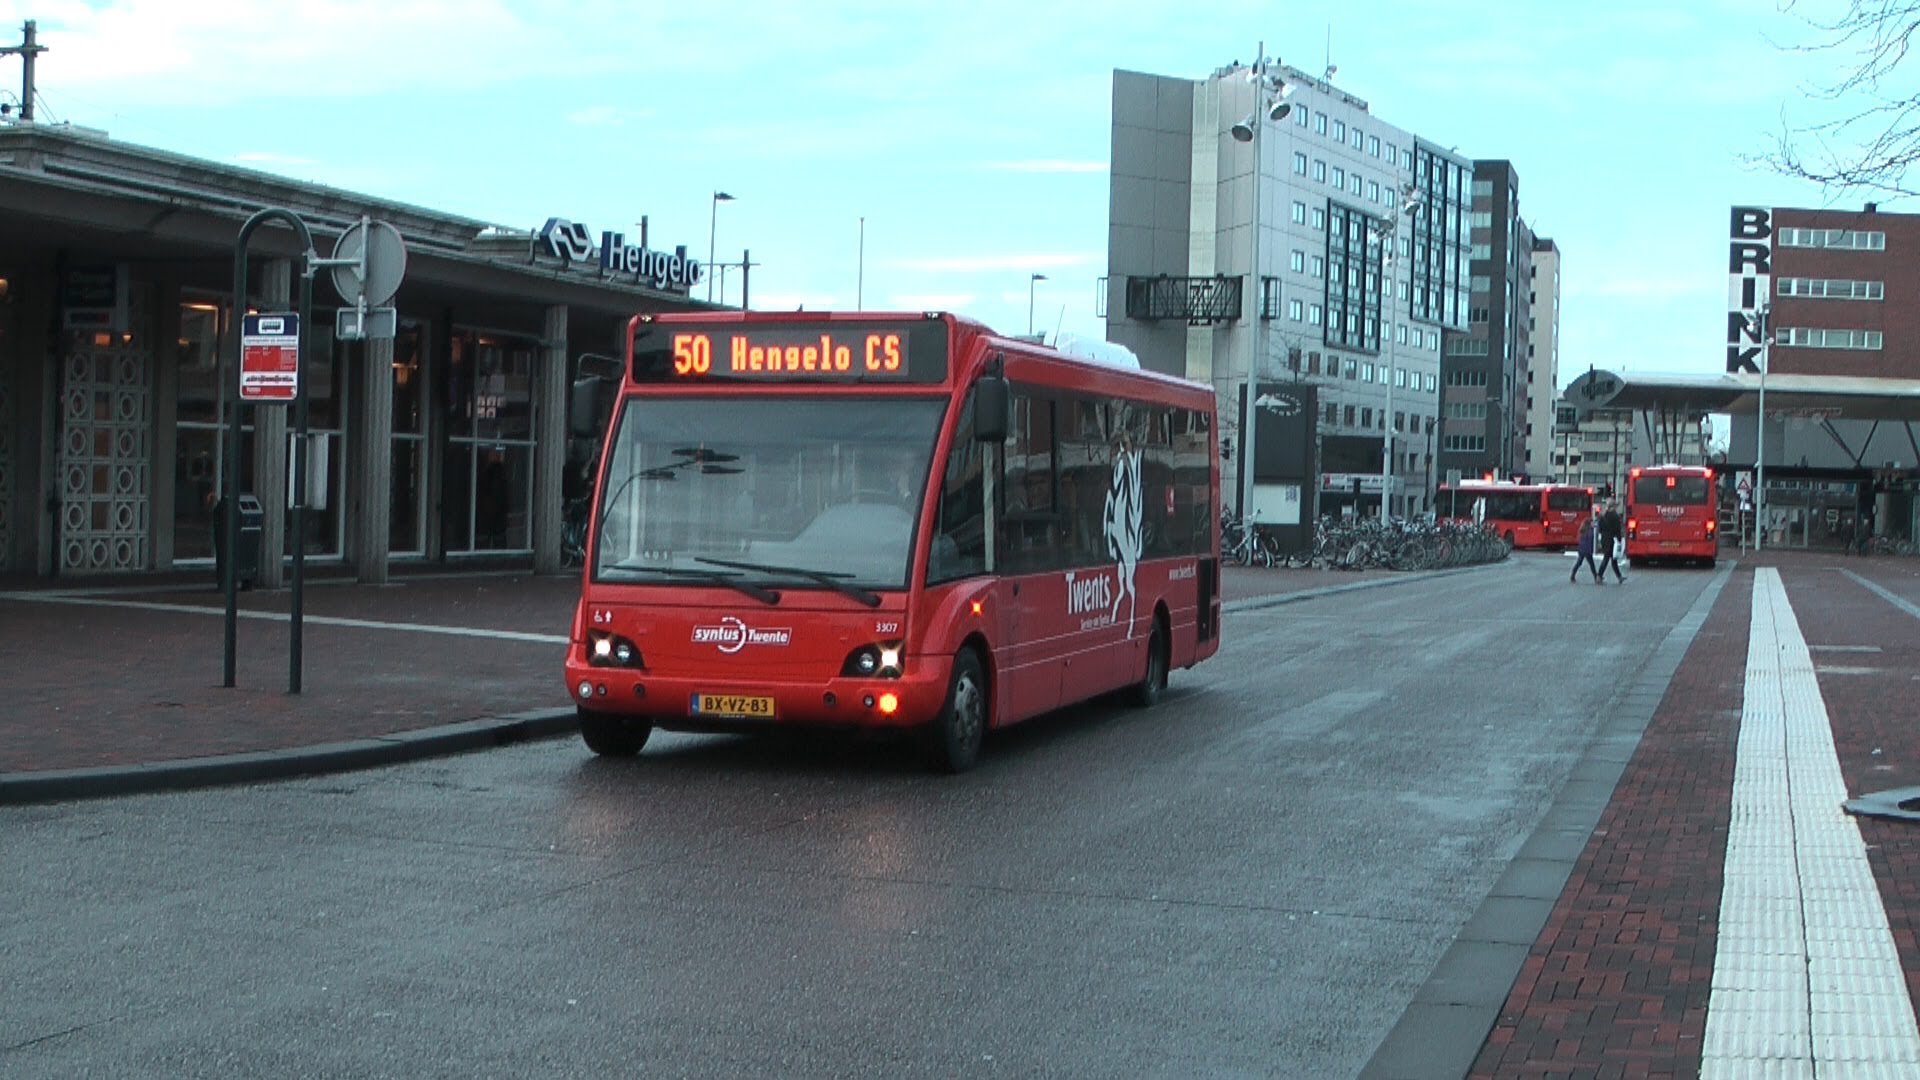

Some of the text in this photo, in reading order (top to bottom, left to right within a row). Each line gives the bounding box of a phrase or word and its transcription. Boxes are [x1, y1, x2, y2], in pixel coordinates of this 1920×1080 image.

[604, 231, 701, 290] Hengelo
[1727, 206, 1772, 374] BRINK
[674, 334, 901, 375] 50 Hengelo CS
[1065, 571, 1111, 615] Twents
[694, 626, 789, 643] syntus Twente
[875, 621, 898, 633] 3307
[704, 697, 769, 713] BX-VZ-83
